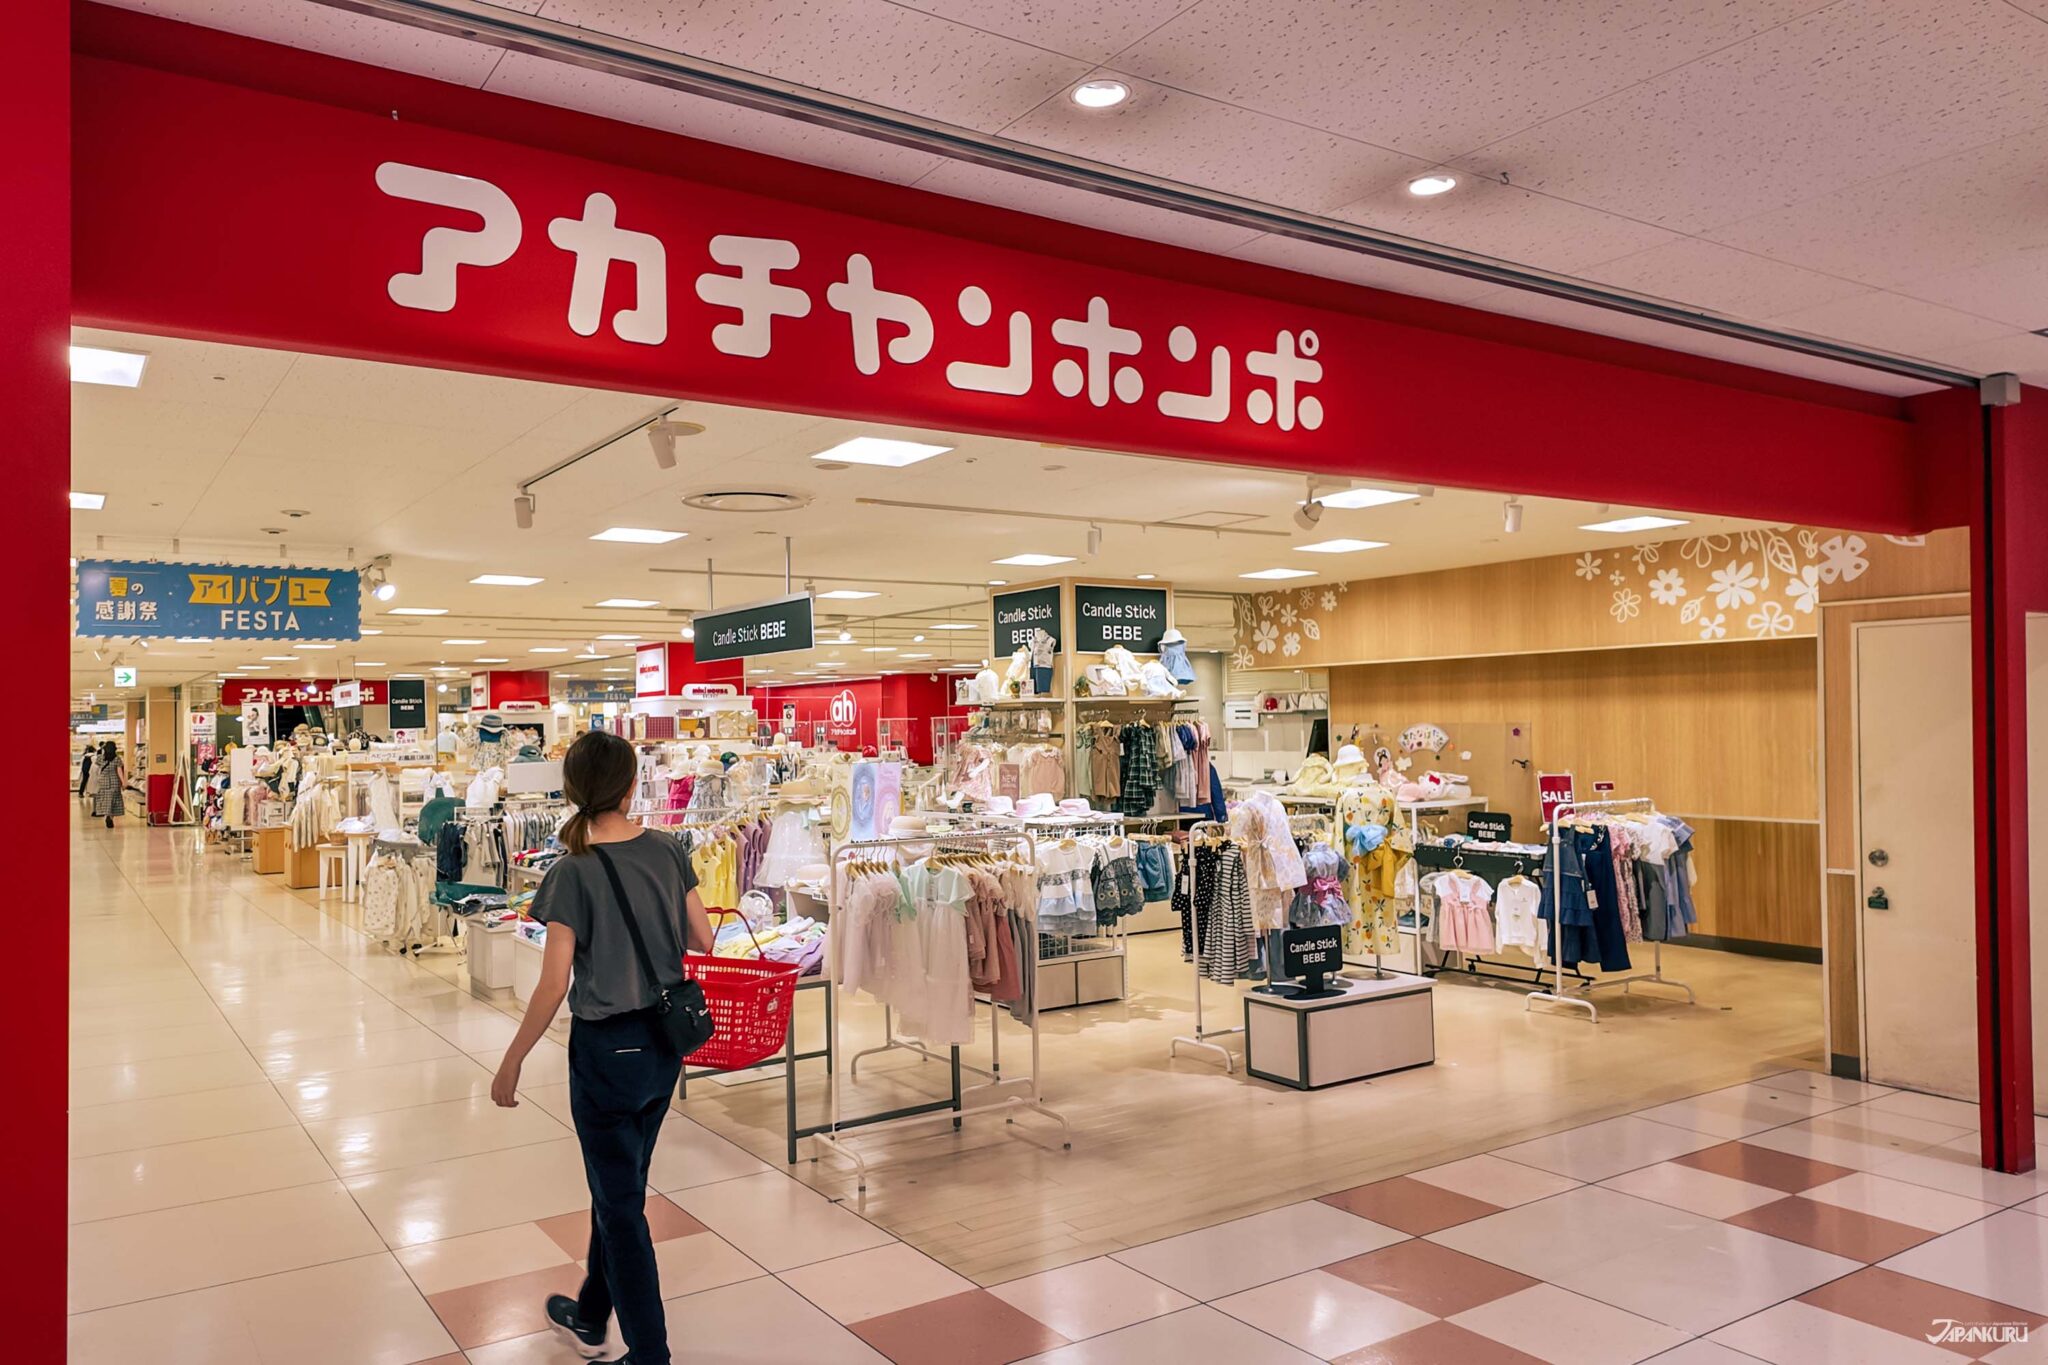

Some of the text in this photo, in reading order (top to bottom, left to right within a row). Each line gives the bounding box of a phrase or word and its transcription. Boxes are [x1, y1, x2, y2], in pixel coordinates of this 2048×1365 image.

[374, 161, 1325, 431] アカチャンホンポ
[109, 575, 322, 606] 夏の アイバブユー
[95, 600, 158, 621] 感謝祭
[997, 604, 1053, 624] Candle Stick
[1082, 602, 1157, 619] Candle Stick
[220, 609, 301, 631] FESTA
[712, 620, 787, 647] Candle Stick BEBE
[1102, 625, 1143, 641] BEBE
[832, 691, 853, 722] ah
[1541, 790, 1572, 803] SALE
[1468, 820, 1506, 832] Candle Stick
[1477, 830, 1497, 840] BEBE
[1289, 937, 1338, 954] Candle Stick
[1302, 951, 1327, 964] BEBE
